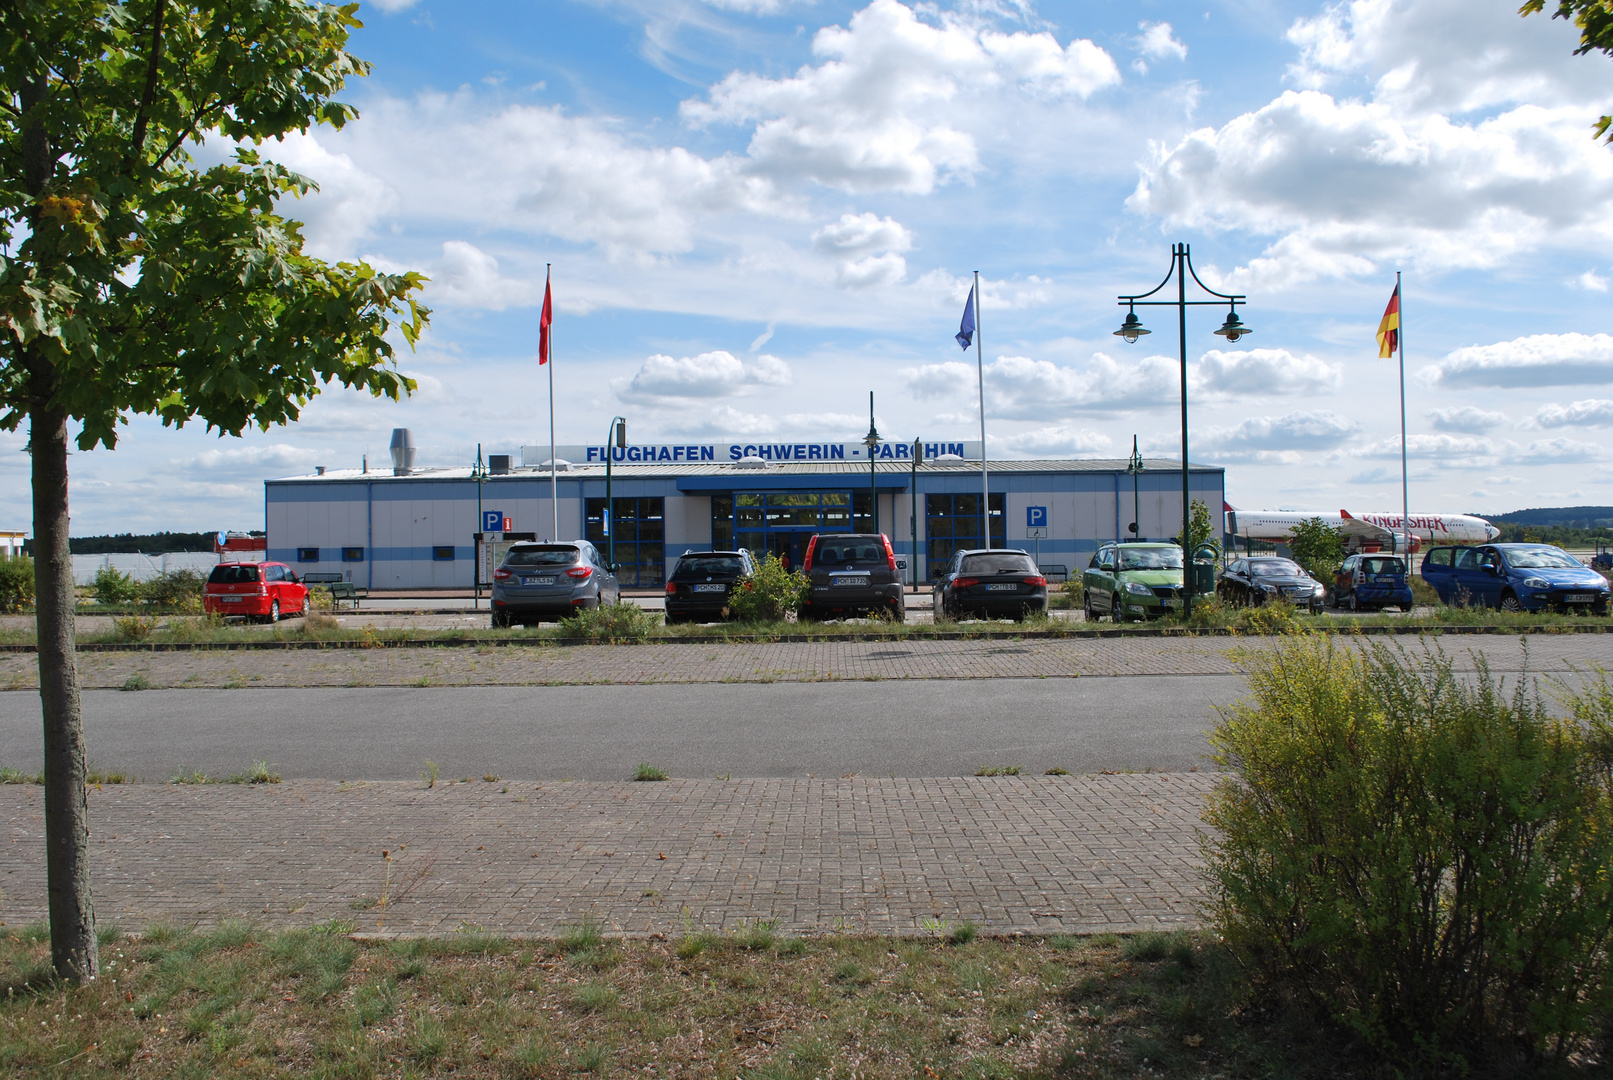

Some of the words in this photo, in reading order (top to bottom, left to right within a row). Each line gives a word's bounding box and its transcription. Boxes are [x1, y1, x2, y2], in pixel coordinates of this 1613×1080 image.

[586, 446, 714, 462] FLUGHAFEN
[729, 444, 844, 460] SCHWERIN
[487, 513, 499, 530] P
[1031, 509, 1042, 525] P
[1362, 514, 1448, 533] KINGFSHER
